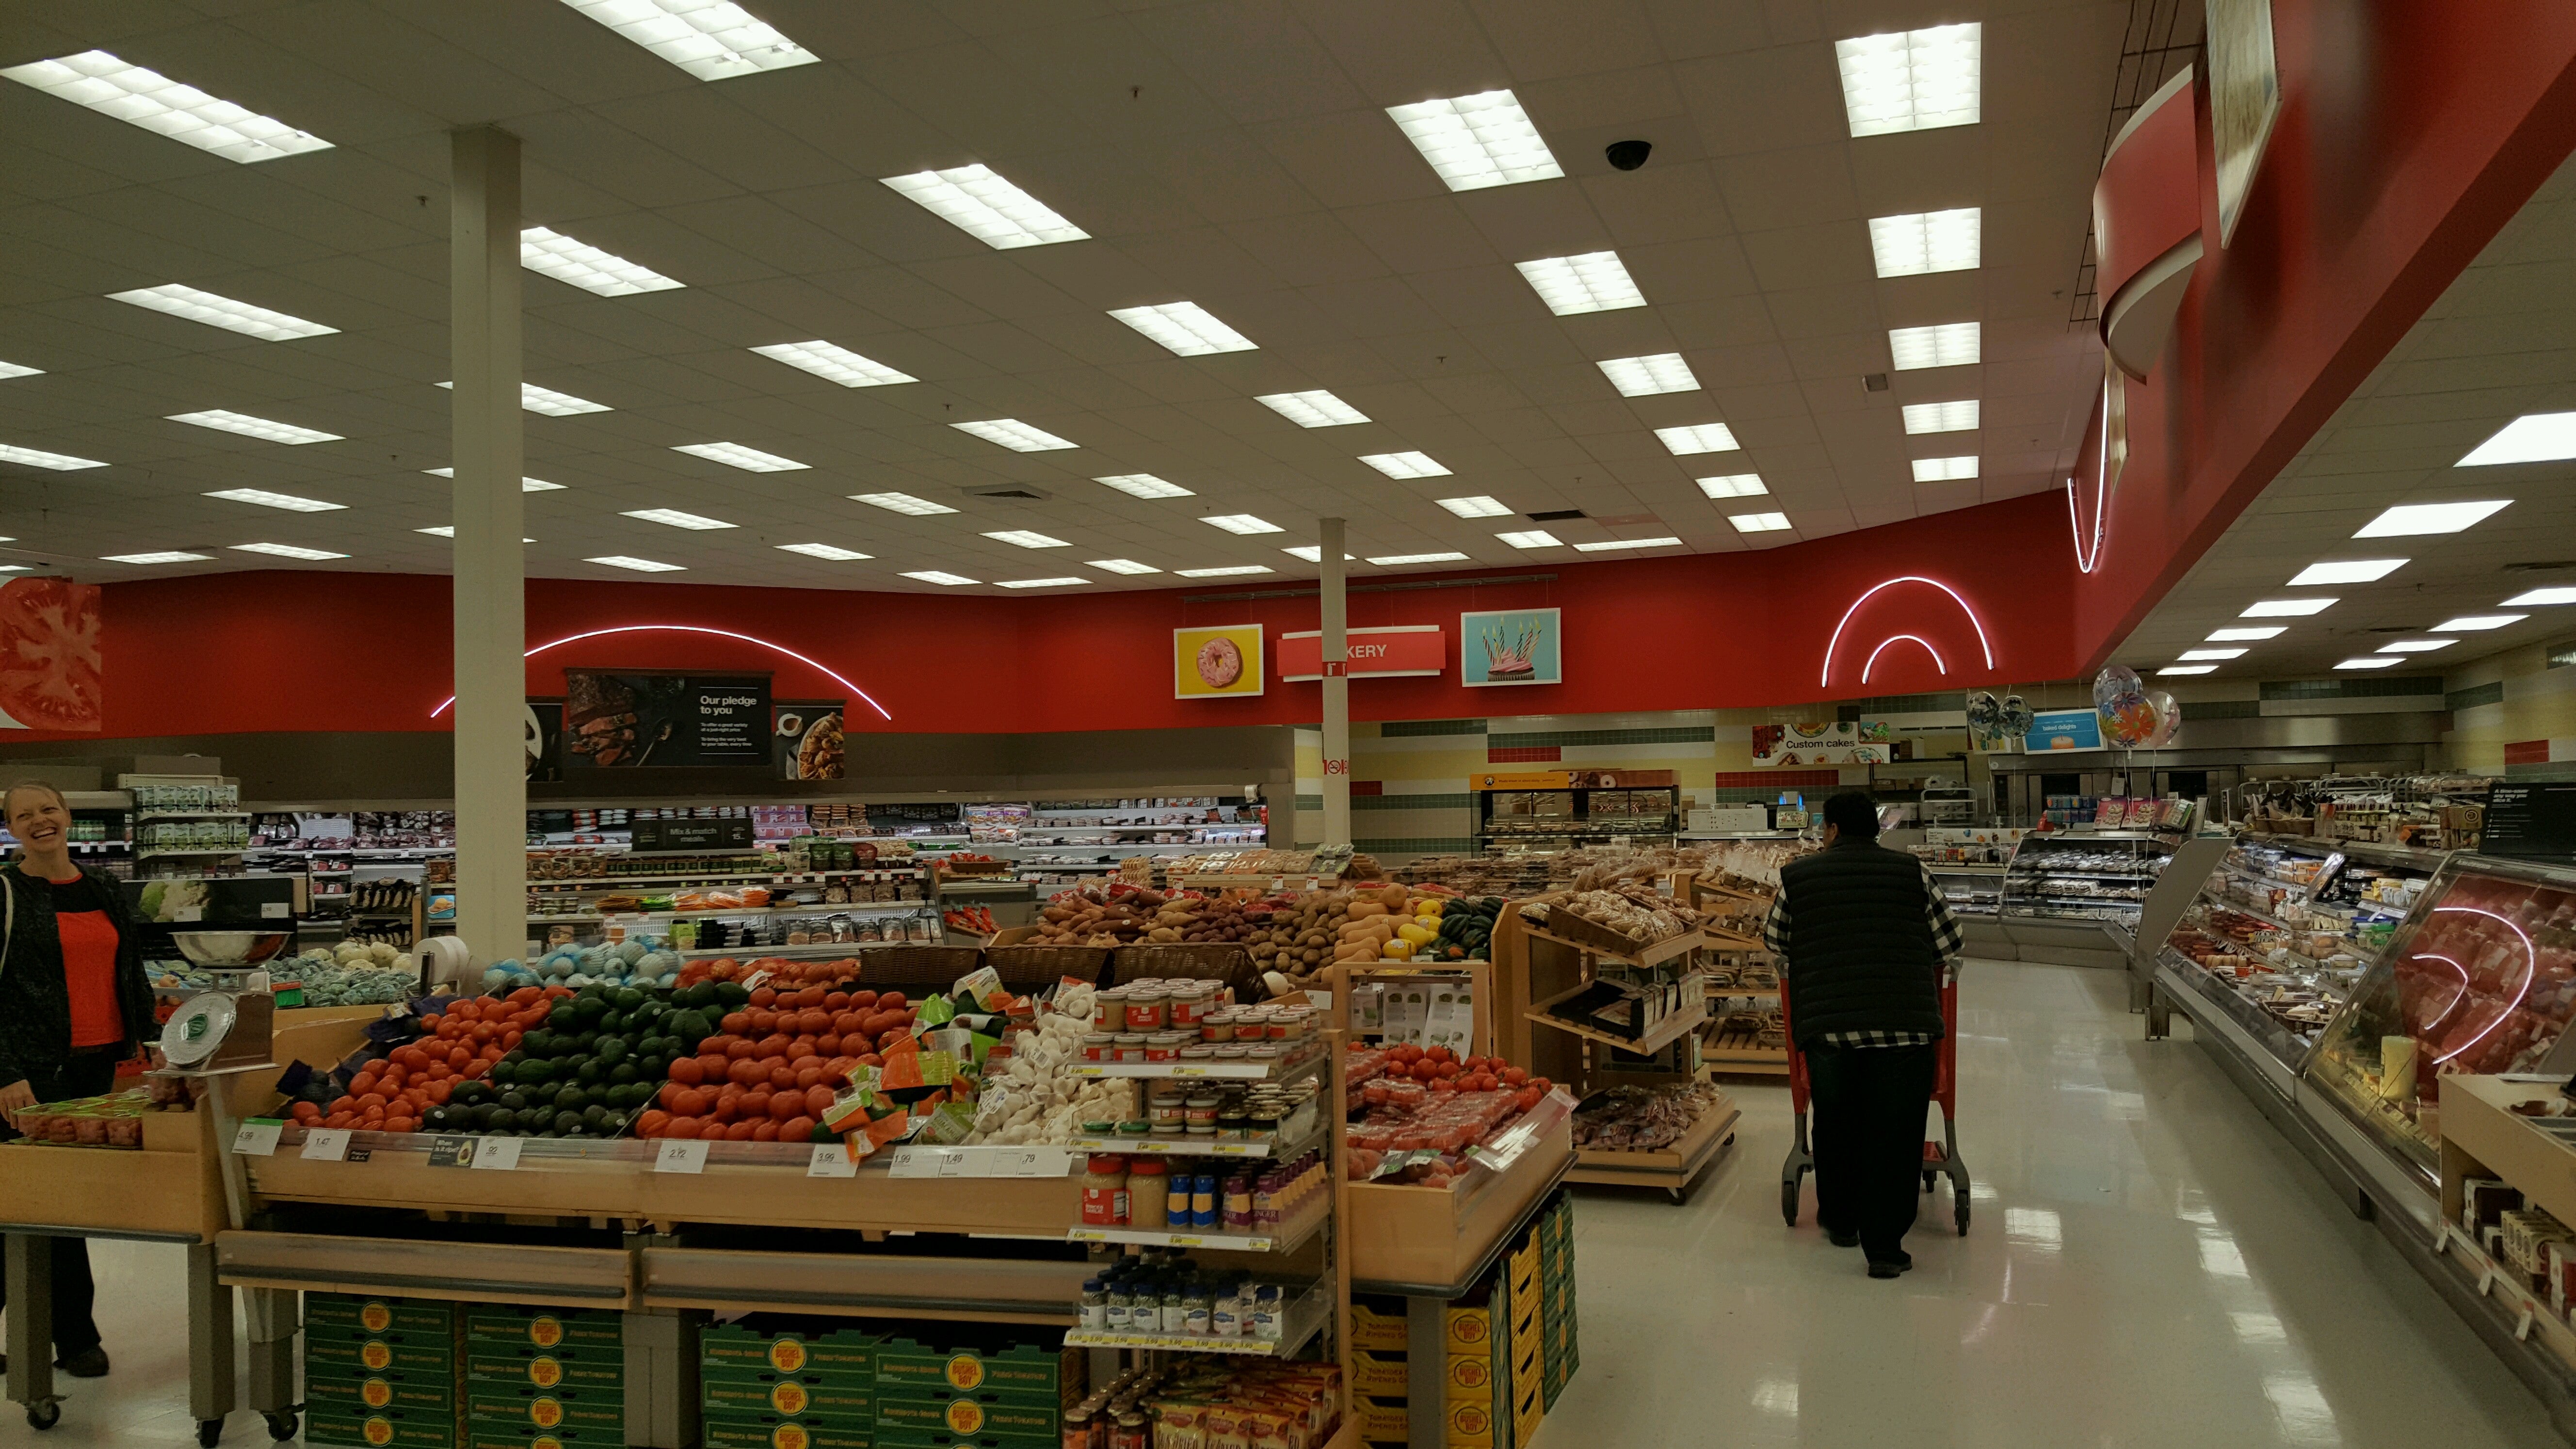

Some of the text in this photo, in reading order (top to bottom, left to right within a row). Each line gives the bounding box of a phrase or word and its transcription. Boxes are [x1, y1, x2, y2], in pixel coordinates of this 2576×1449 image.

[1347, 644, 1387, 659] KERY
[700, 695, 757, 707] Our pledge
[700, 706, 732, 716] to you
[1786, 739, 1855, 749] Custom cakes
[817, 1153, 835, 1162] 3.99
[895, 1155, 911, 1163] 1.99
[946, 1154, 963, 1163] 1.49
[1022, 1154, 1035, 1164] .79
[781, 1359, 794, 1368] BOY
[952, 1364, 977, 1375] BUSHEL
[958, 1375, 972, 1385] BOY
[1465, 1376, 1477, 1385] BOY
[784, 1401, 796, 1410] BOY
[952, 1409, 977, 1420] BUSHEL
[958, 1420, 972, 1430] BOY
[1465, 1423, 1478, 1432] BOY
